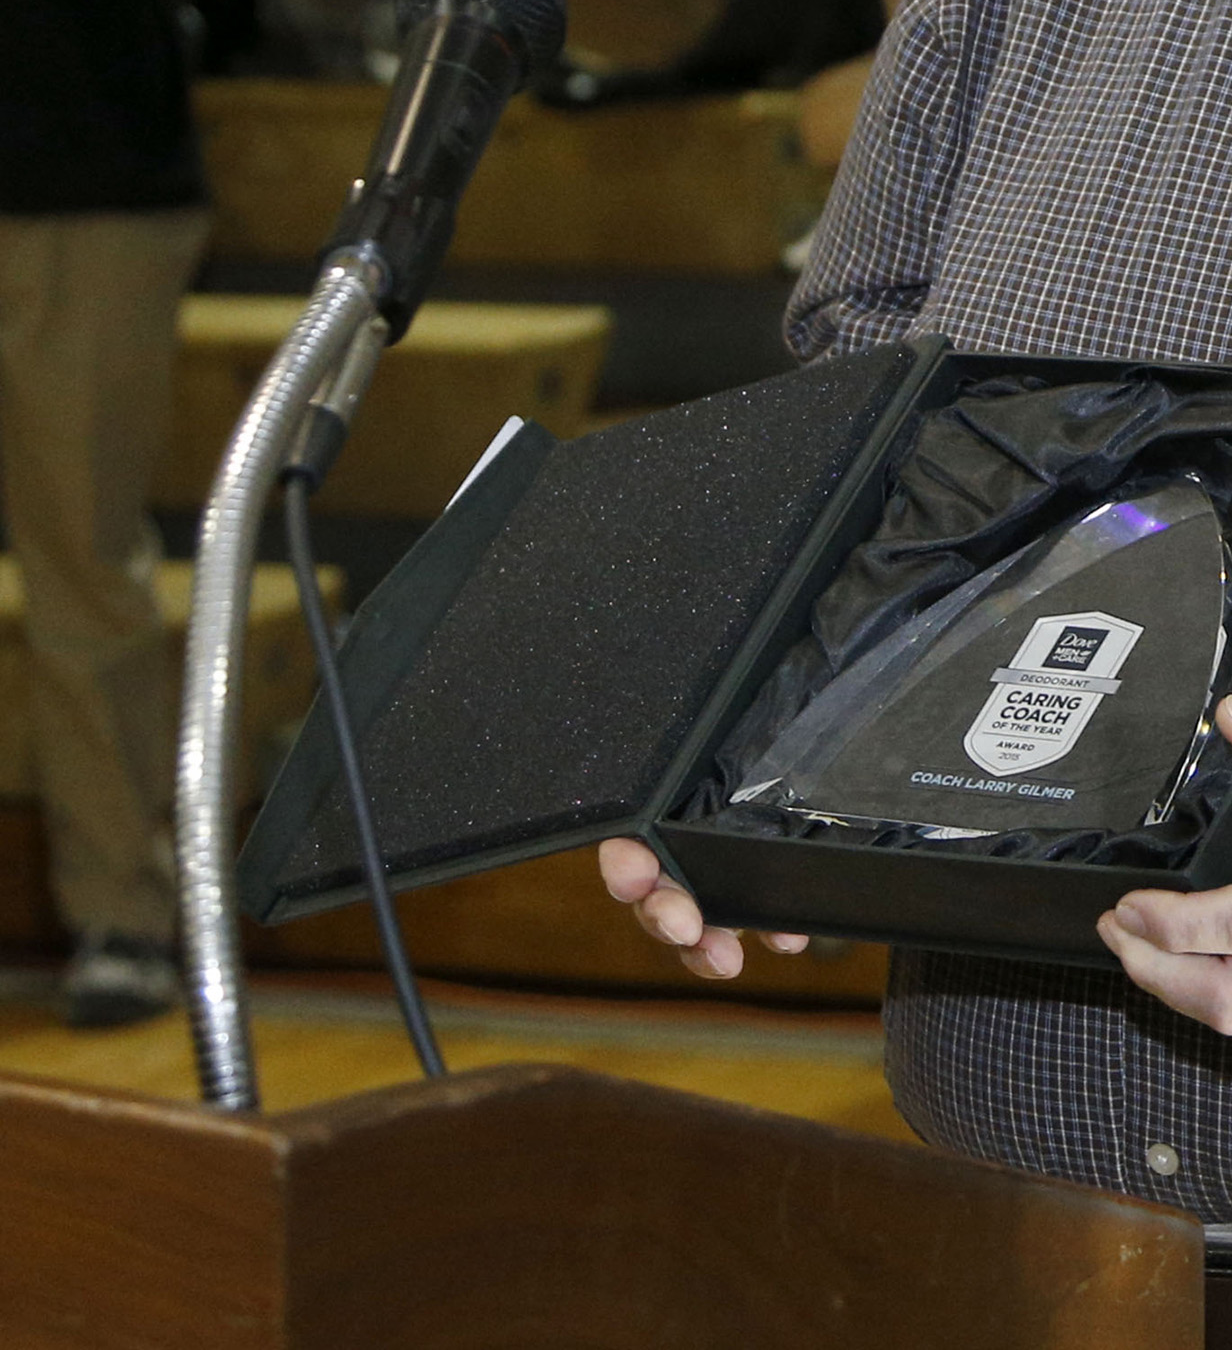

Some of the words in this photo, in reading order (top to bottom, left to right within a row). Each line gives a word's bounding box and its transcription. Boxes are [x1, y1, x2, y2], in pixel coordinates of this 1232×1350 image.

[1060, 633, 1098, 648] Dove
[1055, 647, 1080, 656] MEN
[1020, 674, 1090, 688] DEODORANT
[1006, 691, 1082, 710] CARING
[1000, 706, 1072, 725] COACH
[992, 721, 1008, 730] OF
[1010, 722, 1031, 732] THE
[1034, 725, 1063, 735] YEAR
[996, 741, 1035, 751] AWARD
[910, 771, 964, 787] COACH
[964, 777, 1016, 793] LARRY
[1018, 784, 1075, 800] GILMER
